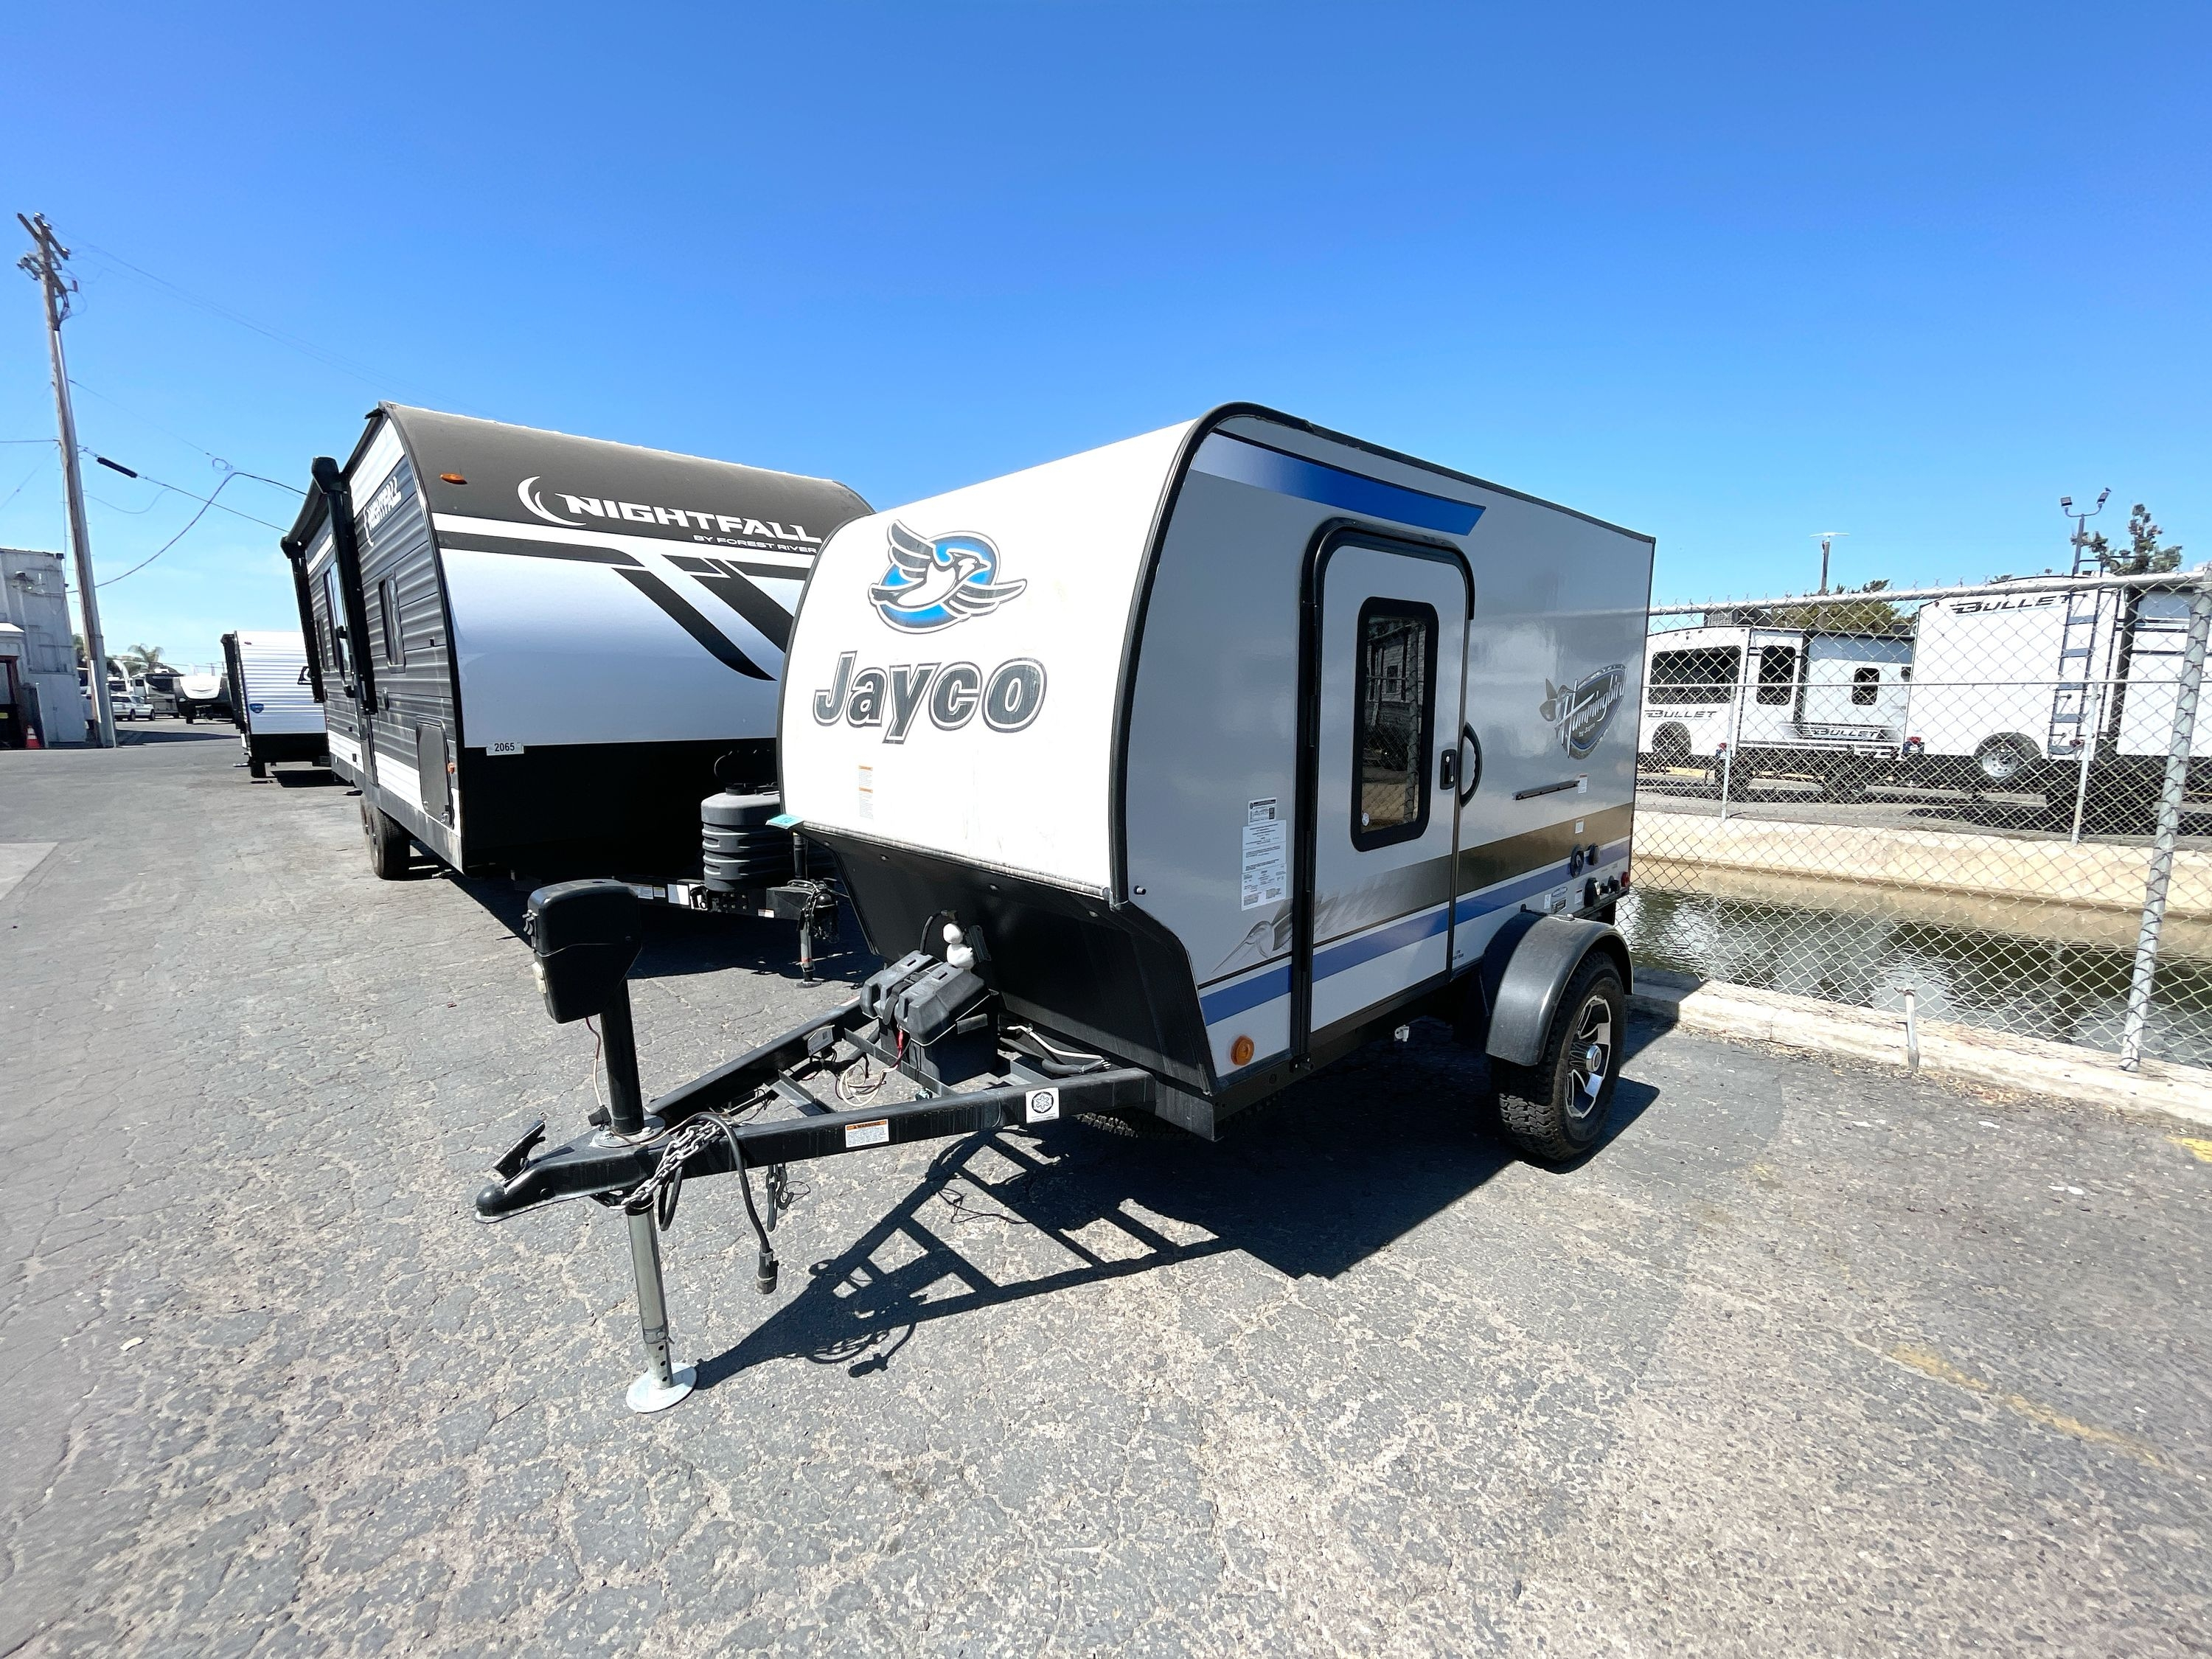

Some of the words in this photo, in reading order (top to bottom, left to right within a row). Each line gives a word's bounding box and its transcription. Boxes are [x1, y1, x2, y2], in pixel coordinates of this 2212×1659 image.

[554, 493, 822, 543] NIGHTFALL
[717, 537, 774, 549] FOREST
[777, 543, 817, 553] RIVER
[1950, 594, 2073, 614] BULLET
[813, 650, 1048, 745] Jayco
[1644, 710, 1717, 718] BULLET
[1801, 727, 1878, 737] BULLET
[494, 742, 515, 752] 2065
